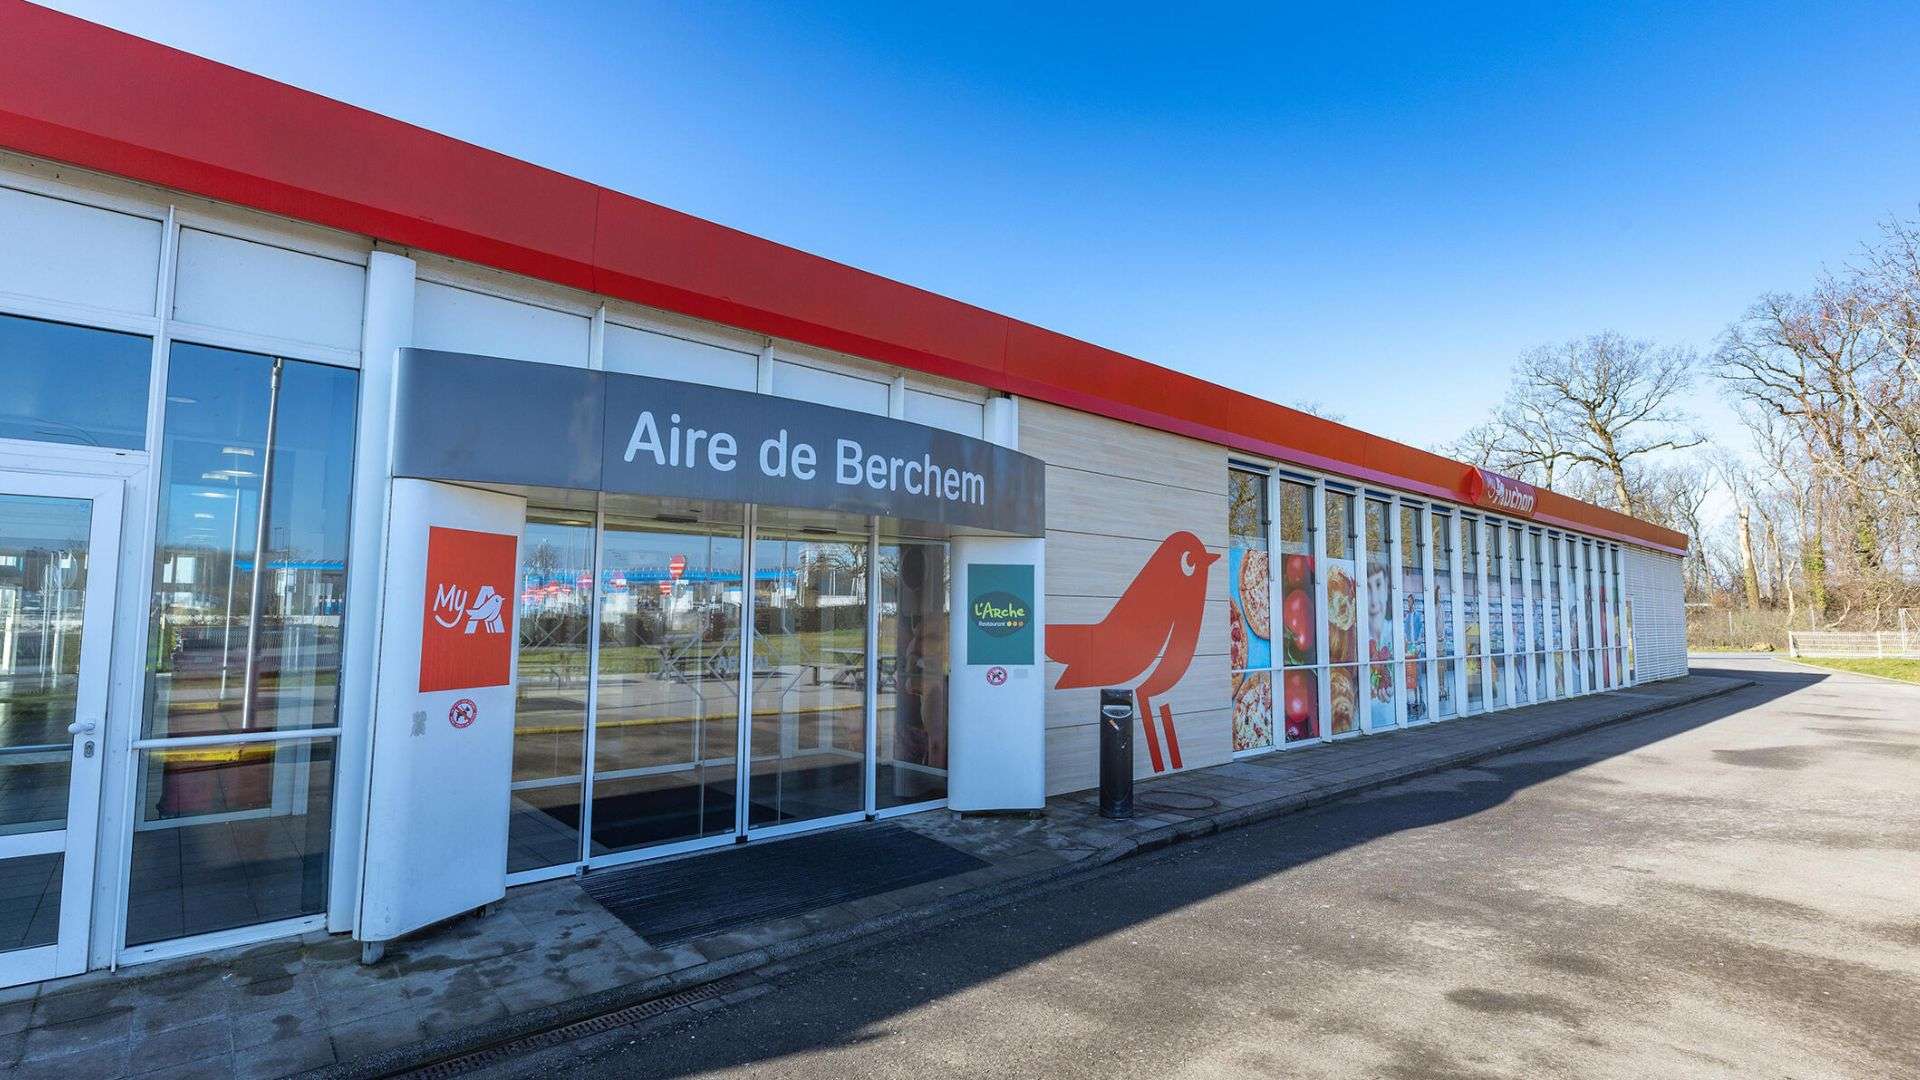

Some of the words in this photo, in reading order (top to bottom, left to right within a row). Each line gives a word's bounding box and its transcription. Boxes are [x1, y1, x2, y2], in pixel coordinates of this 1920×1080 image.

[624, 411, 738, 472] Aire
[759, 429, 817, 480] de
[836, 438, 985, 505] Berchem
[1492, 478, 1534, 512] Auchan
[433, 583, 467, 629] My
